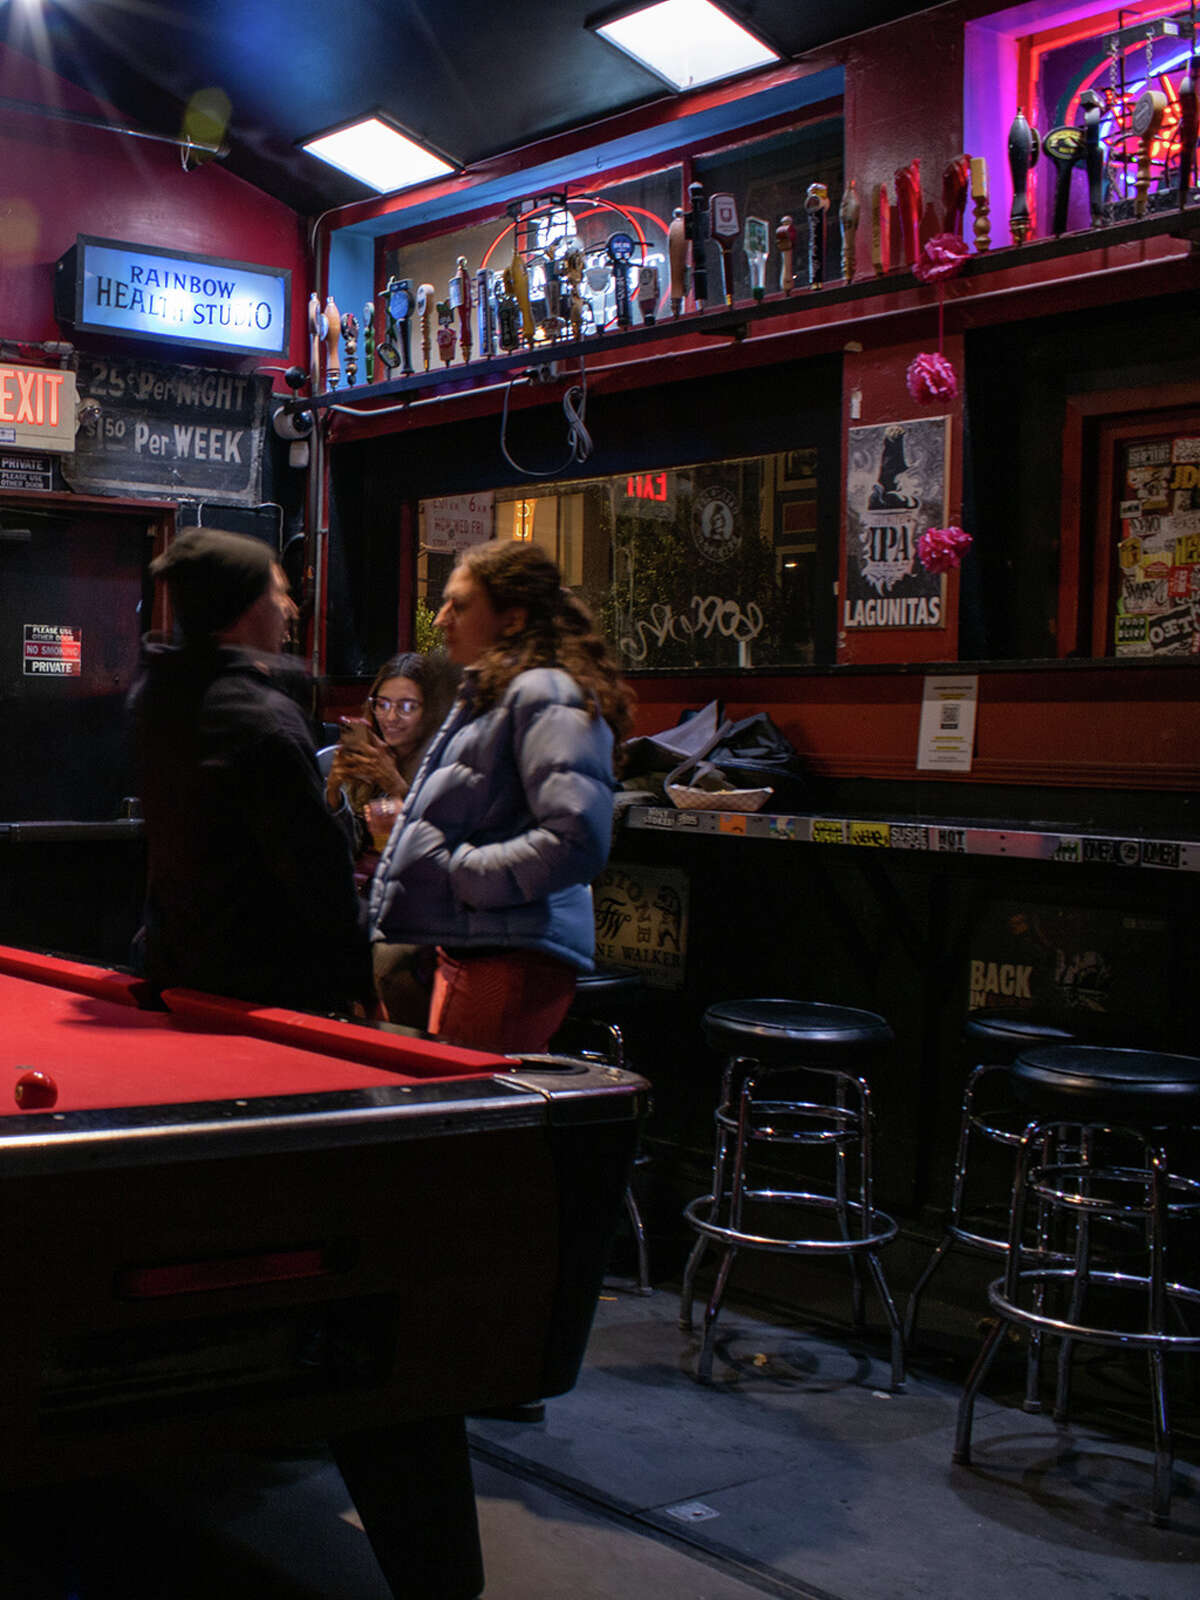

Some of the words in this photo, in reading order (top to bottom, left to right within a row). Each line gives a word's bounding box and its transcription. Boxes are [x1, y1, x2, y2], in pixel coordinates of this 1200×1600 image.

[130, 265, 237, 299] RAINBOW
[193, 302, 273, 331] STUIO
[136, 368, 173, 400] Per
[135, 421, 170, 456] Per
[173, 424, 245, 464] WEEK
[2, 456, 44, 471] PRIVATE
[2, 472, 28, 481] PLEASE
[29, 474, 43, 482] USE
[1, 479, 24, 488] OTHER
[869, 525, 910, 563] IPA
[844, 595, 941, 627] LAGUNITAS
[32, 626, 58, 635] PLEASE
[26, 645, 39, 655] NO
[32, 660, 73, 673] PRIVATE
[621, 945, 681, 970] WALKER
[969, 960, 1033, 999] BACK
